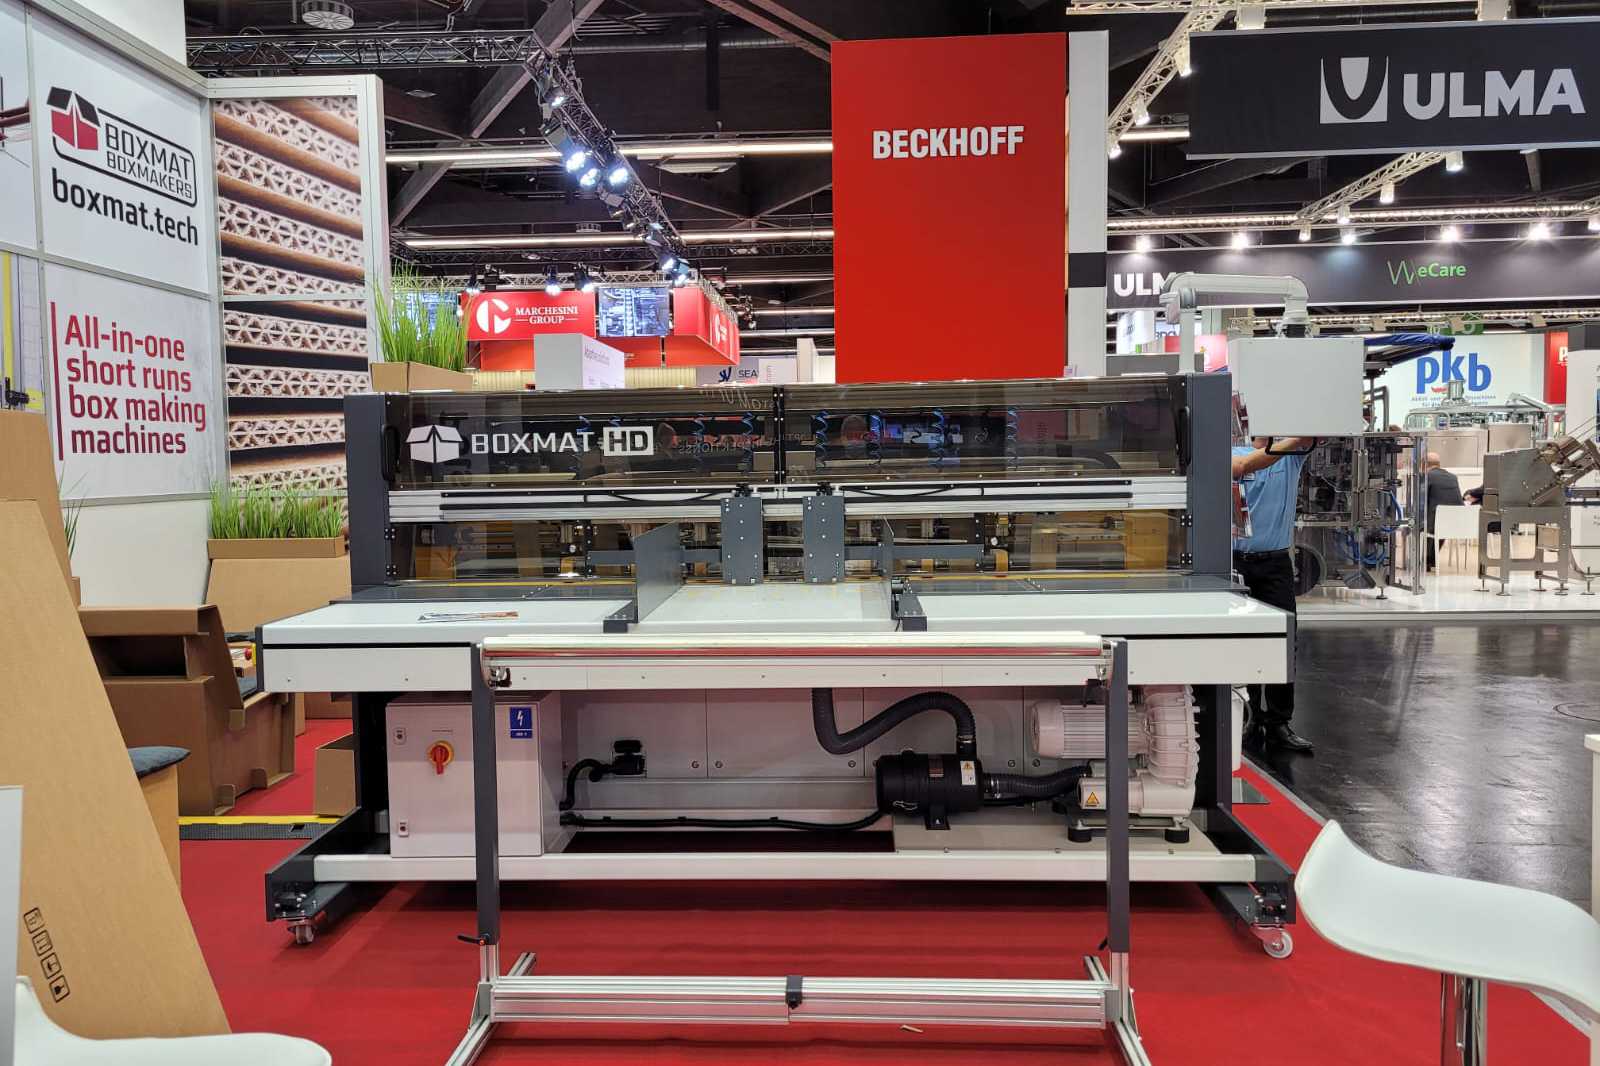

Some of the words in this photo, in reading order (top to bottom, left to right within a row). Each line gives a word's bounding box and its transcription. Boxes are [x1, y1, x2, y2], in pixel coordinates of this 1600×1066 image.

[1403, 68, 1586, 120] ULMA
[106, 123, 191, 180] BOXMAT
[873, 125, 1025, 159] BECKHOFF
[107, 151, 192, 199] BOXMAKERS
[52, 168, 198, 246] boxmat.tech
[1113, 271, 1194, 297] ULM
[515, 306, 578, 315] MARCHESINI
[529, 315, 565, 325] GROUP
[65, 314, 185, 361] All-in-one
[66, 350, 137, 388] short
[143, 366, 192, 393] runs
[1416, 350, 1492, 395] pkb
[69, 384, 119, 419] box
[126, 392, 206, 432] making
[72, 423, 186, 454] machines
[471, 431, 595, 454] BOXMAT
[606, 428, 651, 454] HD
